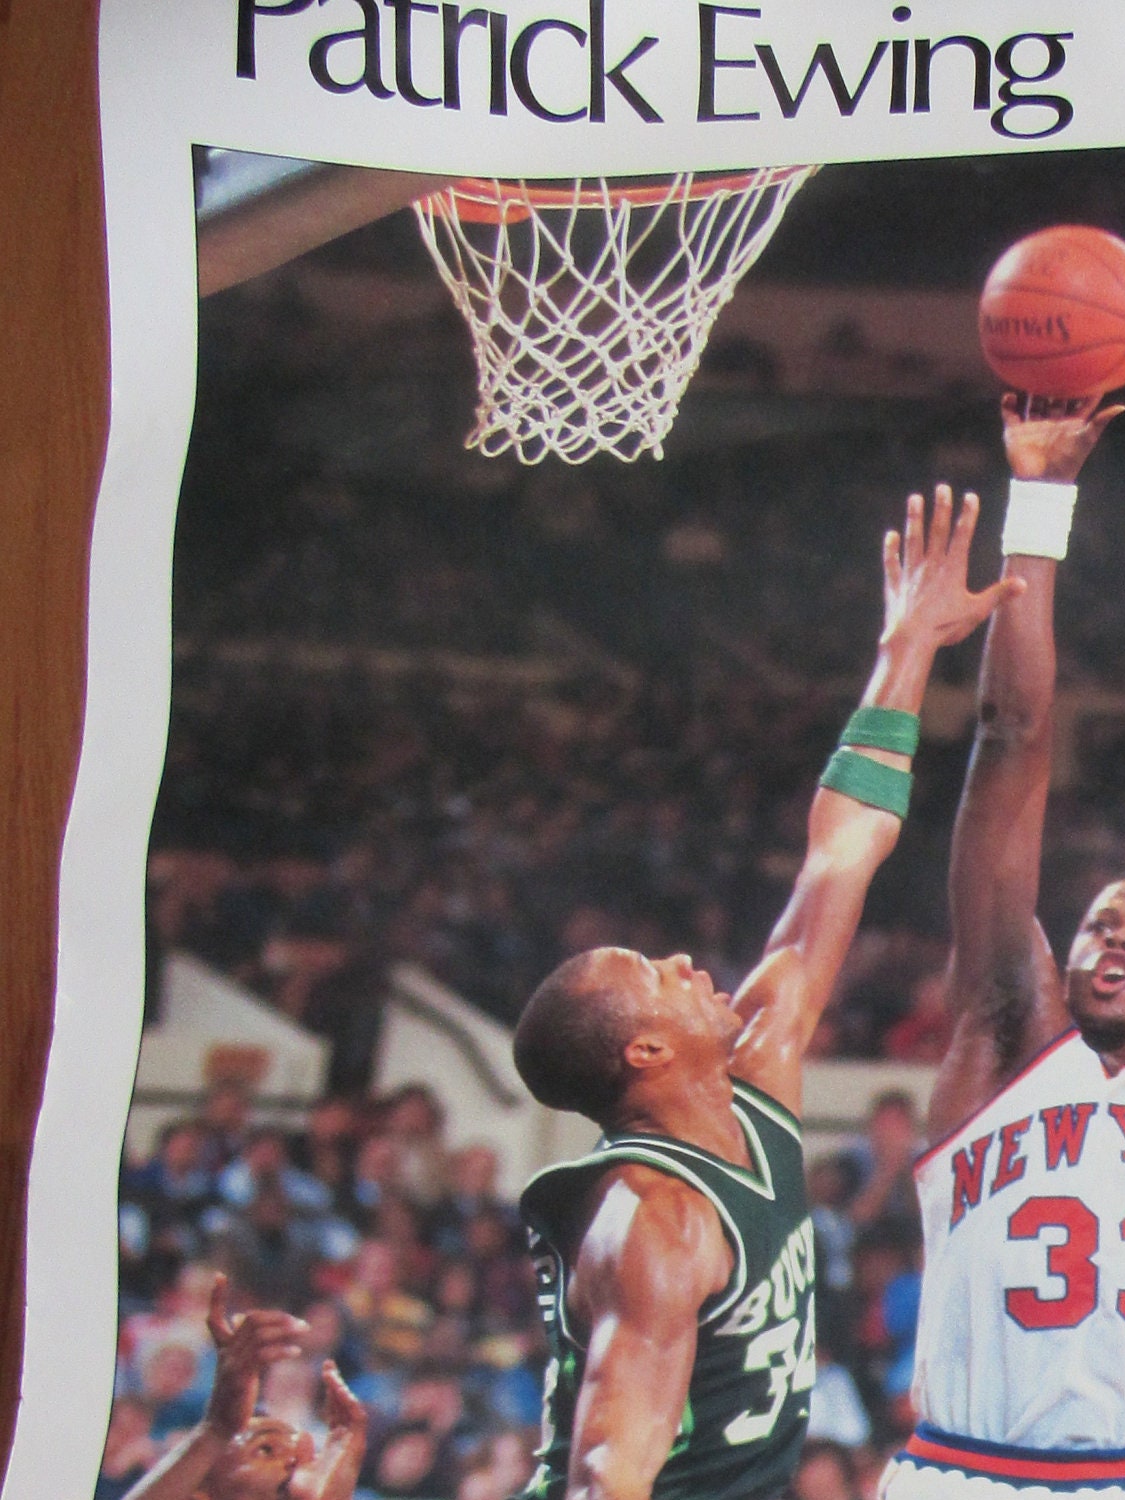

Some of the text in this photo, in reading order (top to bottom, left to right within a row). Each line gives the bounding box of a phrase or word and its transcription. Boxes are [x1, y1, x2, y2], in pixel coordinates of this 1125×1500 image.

[234, 0, 1074, 140] Patrick Ewing
[949, 1101, 1099, 1236] NEW
